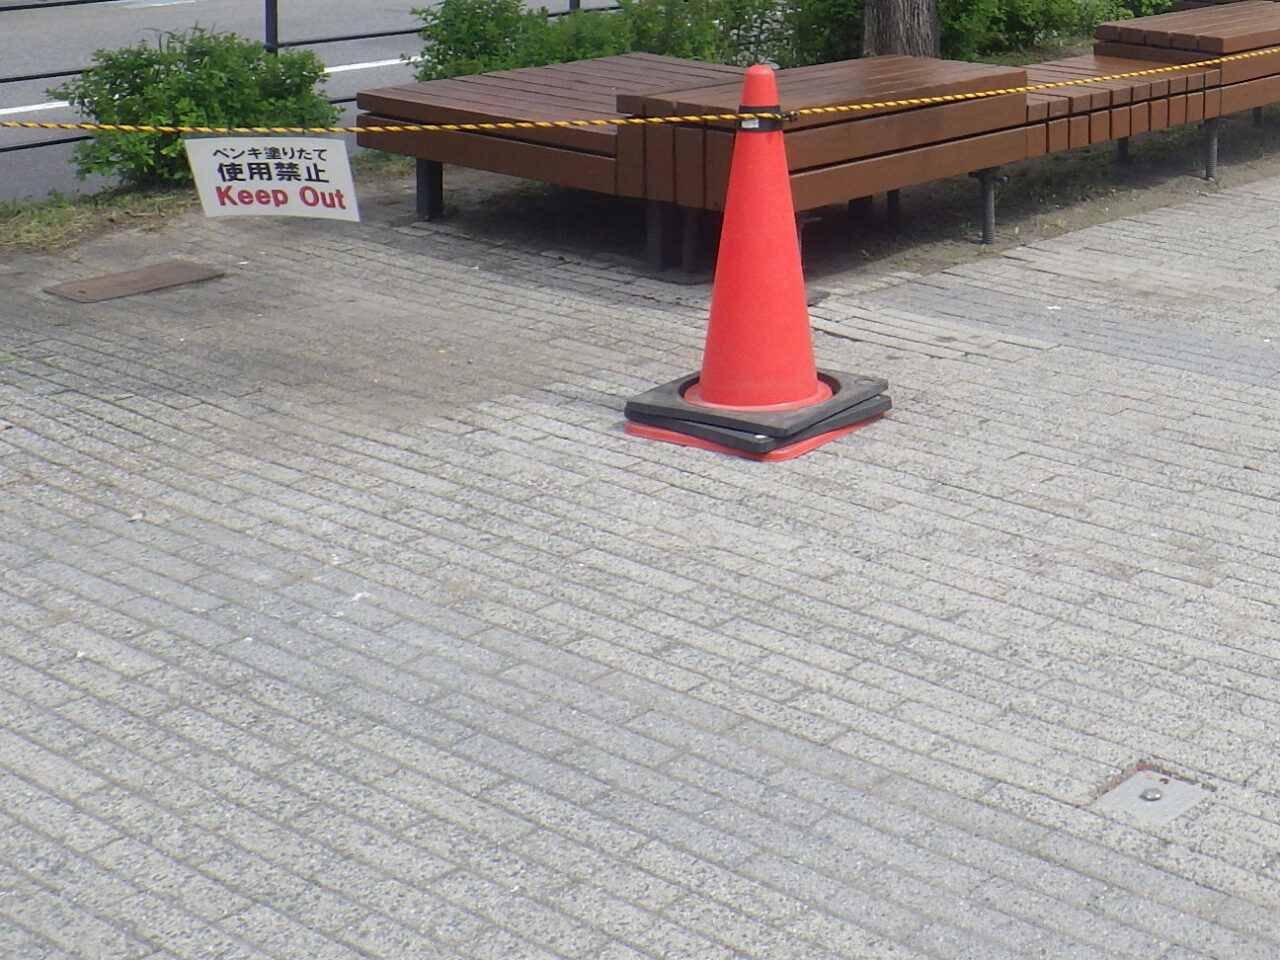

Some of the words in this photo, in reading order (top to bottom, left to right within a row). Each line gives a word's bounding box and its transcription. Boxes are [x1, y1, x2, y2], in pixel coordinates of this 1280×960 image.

[213, 146, 328, 161] ペンキ塗りたて
[217, 162, 330, 184] 使用禁止
[215, 185, 289, 207] Keep
[299, 185, 347, 210] Out
